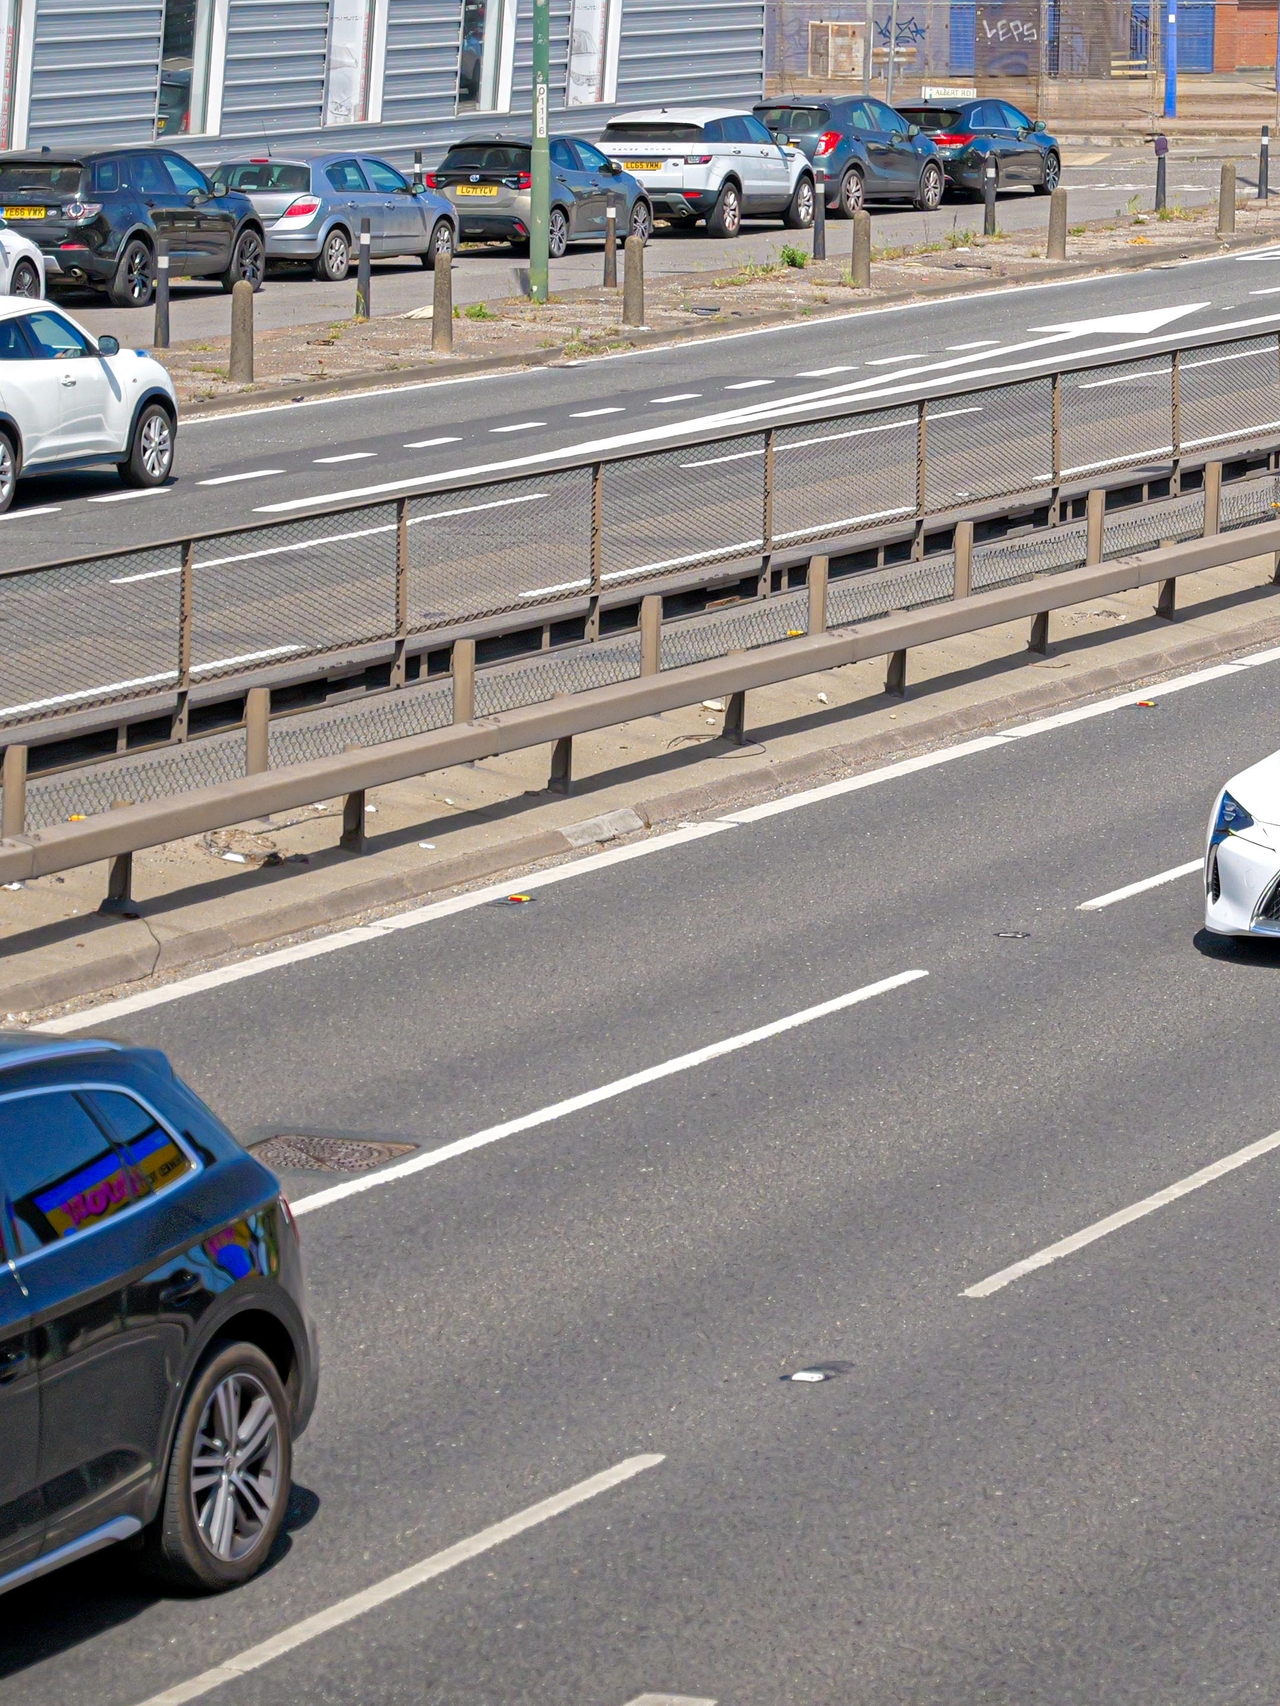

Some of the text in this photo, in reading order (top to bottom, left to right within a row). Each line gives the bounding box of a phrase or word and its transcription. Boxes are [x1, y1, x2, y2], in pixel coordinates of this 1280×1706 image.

[982, 19, 1037, 42] LEPS
[935, 88, 972, 97] ALBERT RD
[538, 86, 546, 135] 01116
[5, 207, 26, 216] YE66
